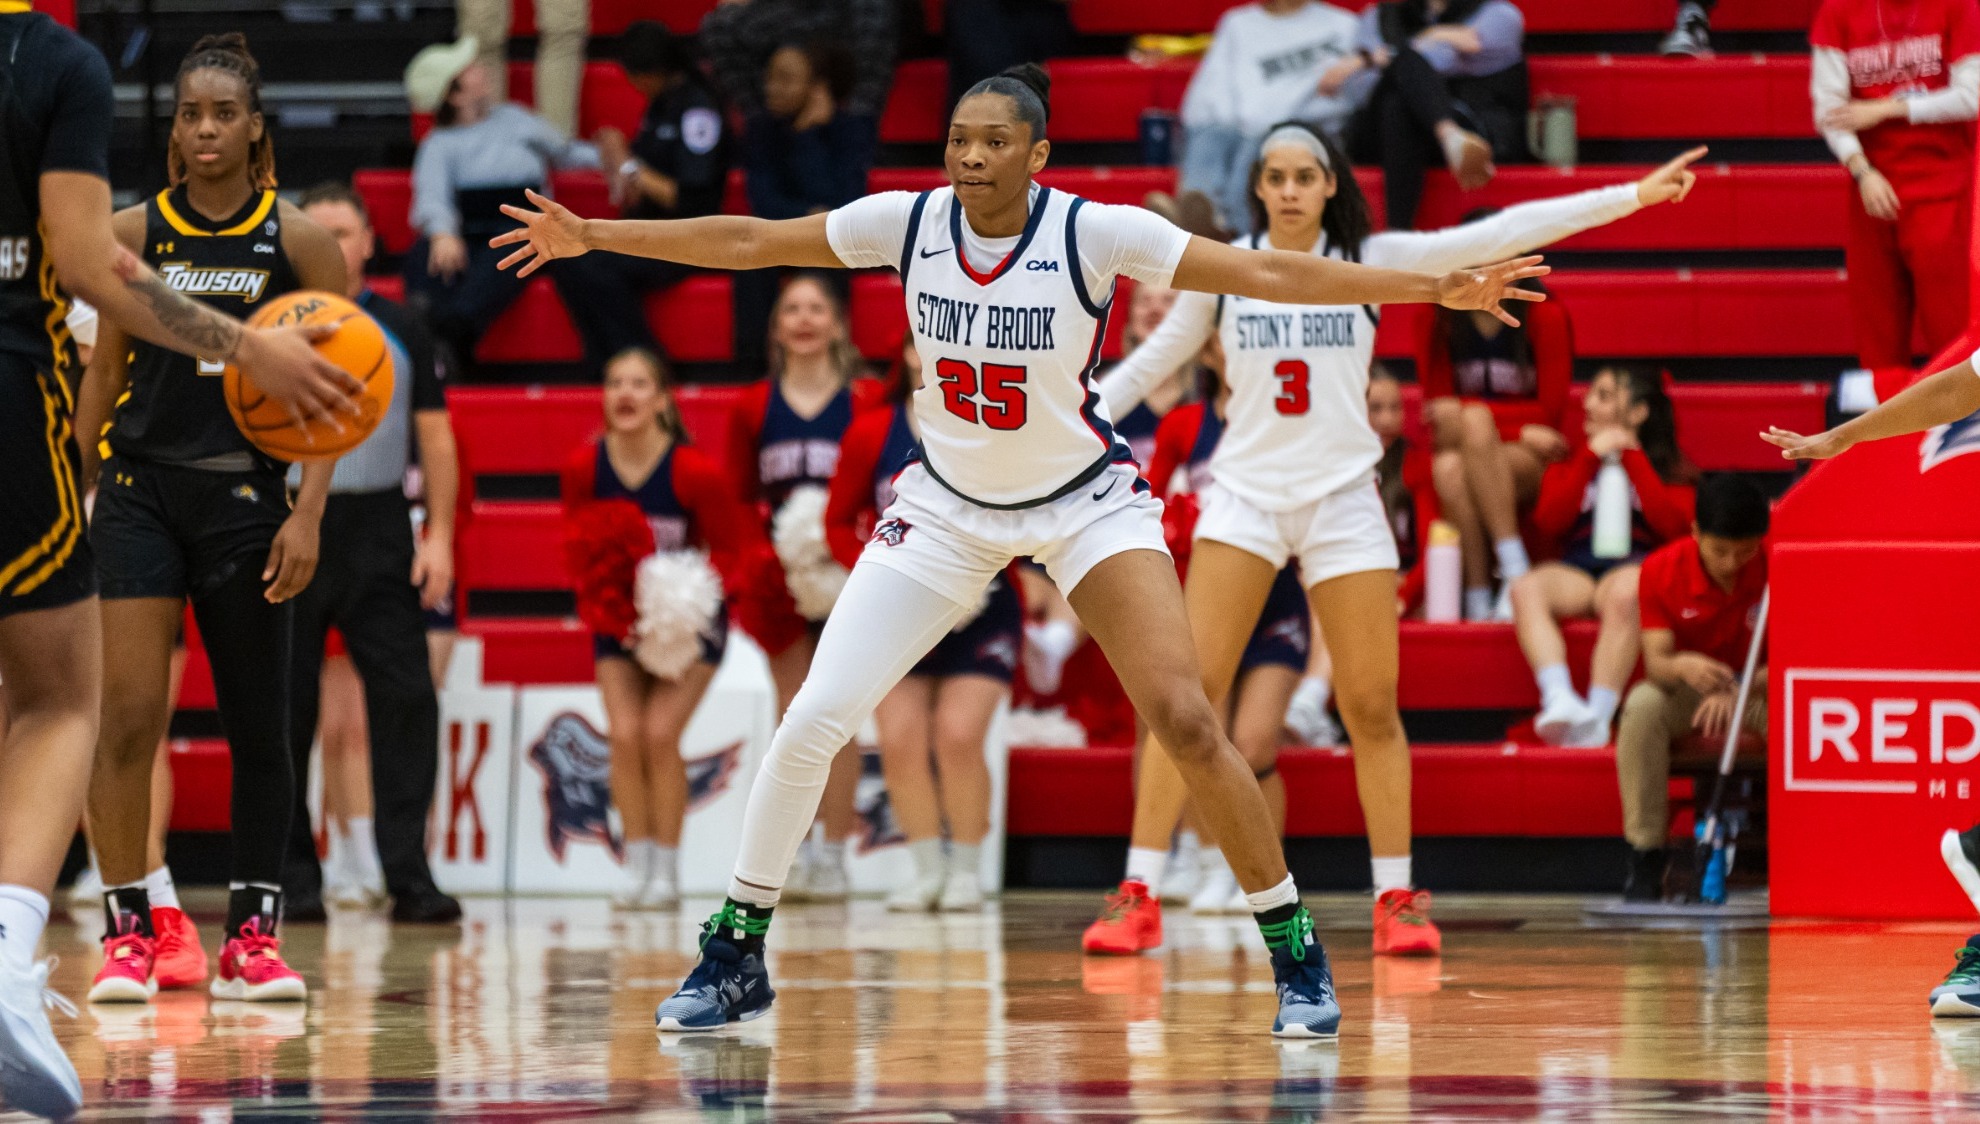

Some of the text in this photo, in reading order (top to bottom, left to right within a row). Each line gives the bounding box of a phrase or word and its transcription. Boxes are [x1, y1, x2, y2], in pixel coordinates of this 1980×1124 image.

[253, 243, 276, 254] CAA
[1026, 259, 1059, 272] CAA
[917, 292, 1056, 350] STONY BROOK
[1237, 312, 1355, 349] STONY BROOK
[936, 357, 1027, 431] 25
[1274, 359, 1310, 416] 3
